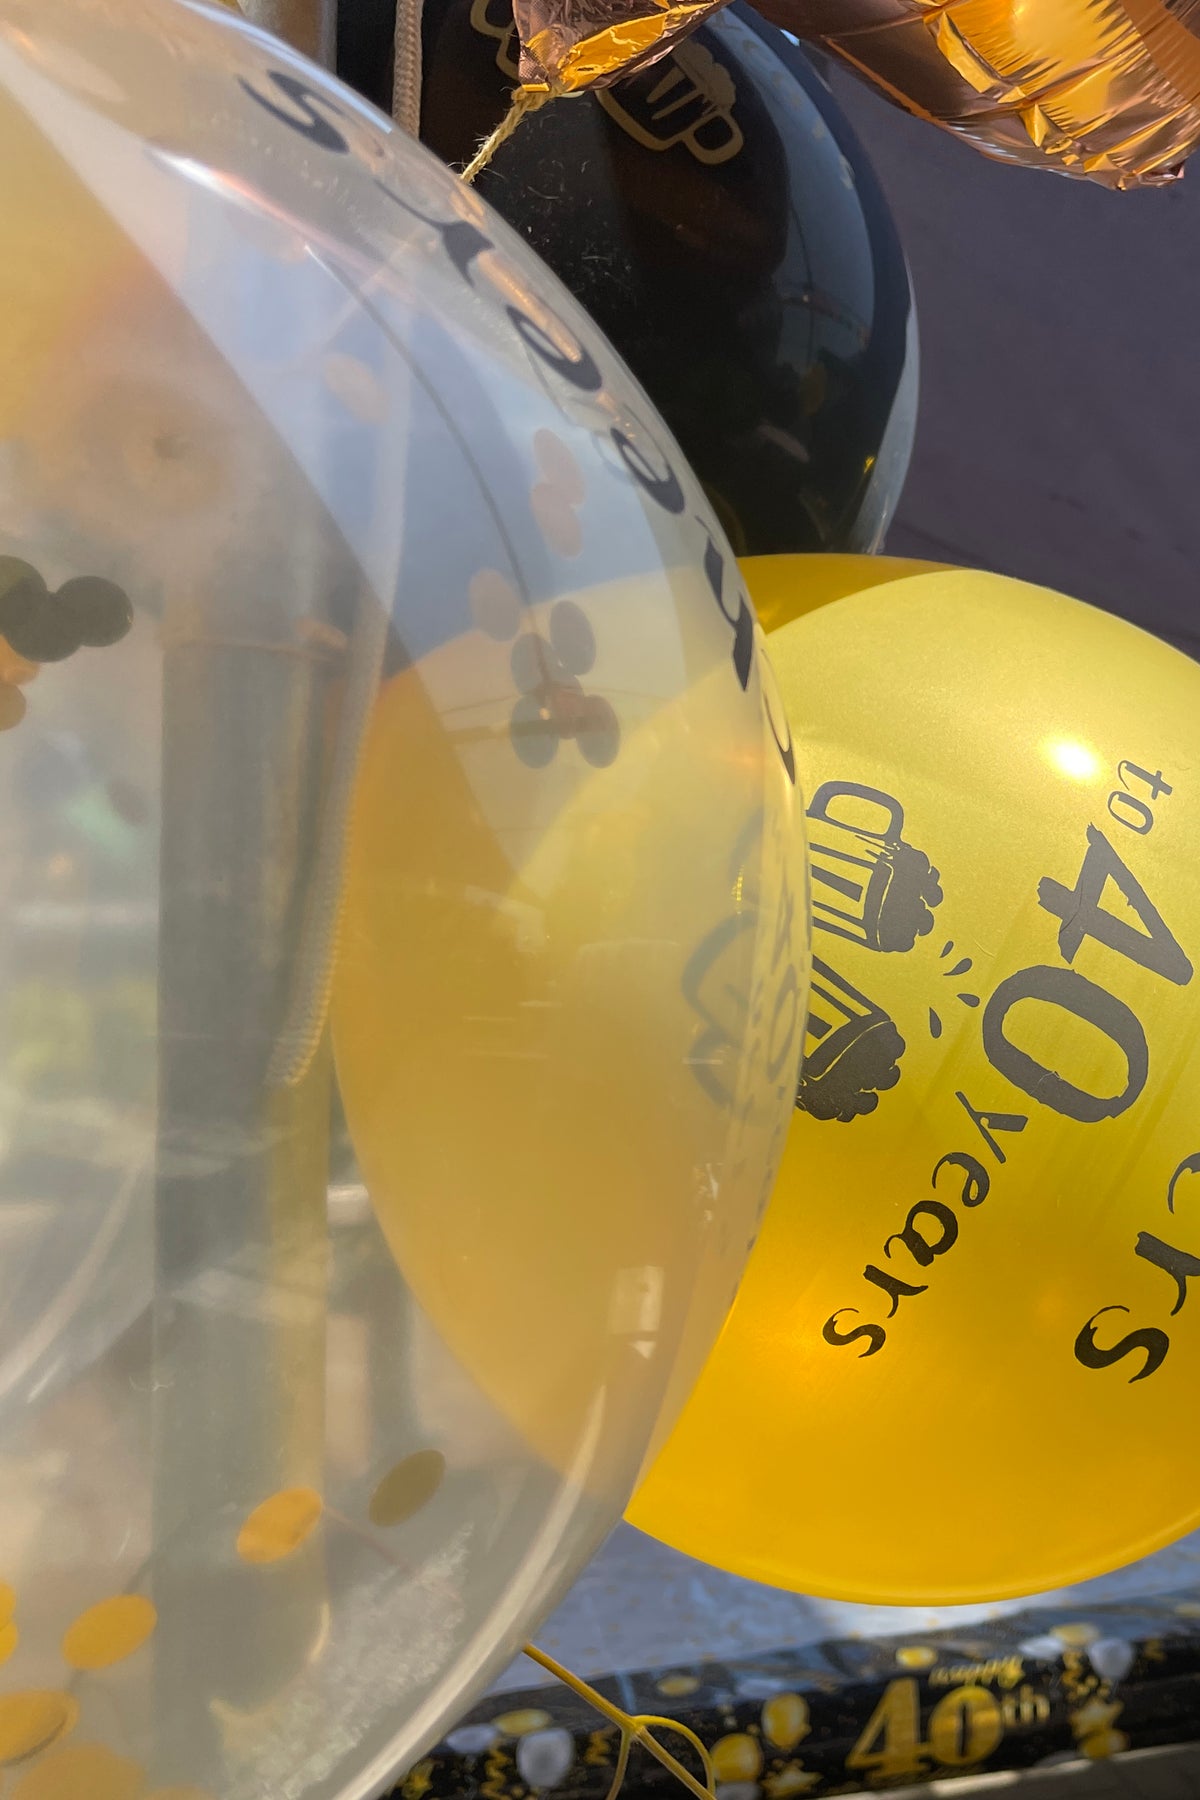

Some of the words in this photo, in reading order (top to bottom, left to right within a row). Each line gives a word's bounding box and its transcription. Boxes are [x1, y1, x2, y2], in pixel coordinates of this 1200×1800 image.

[1108, 759, 1173, 835] to
[983, 821, 1194, 1124] 40
[821, 1091, 1029, 1359] years
[844, 1676, 1051, 1780] 40th
